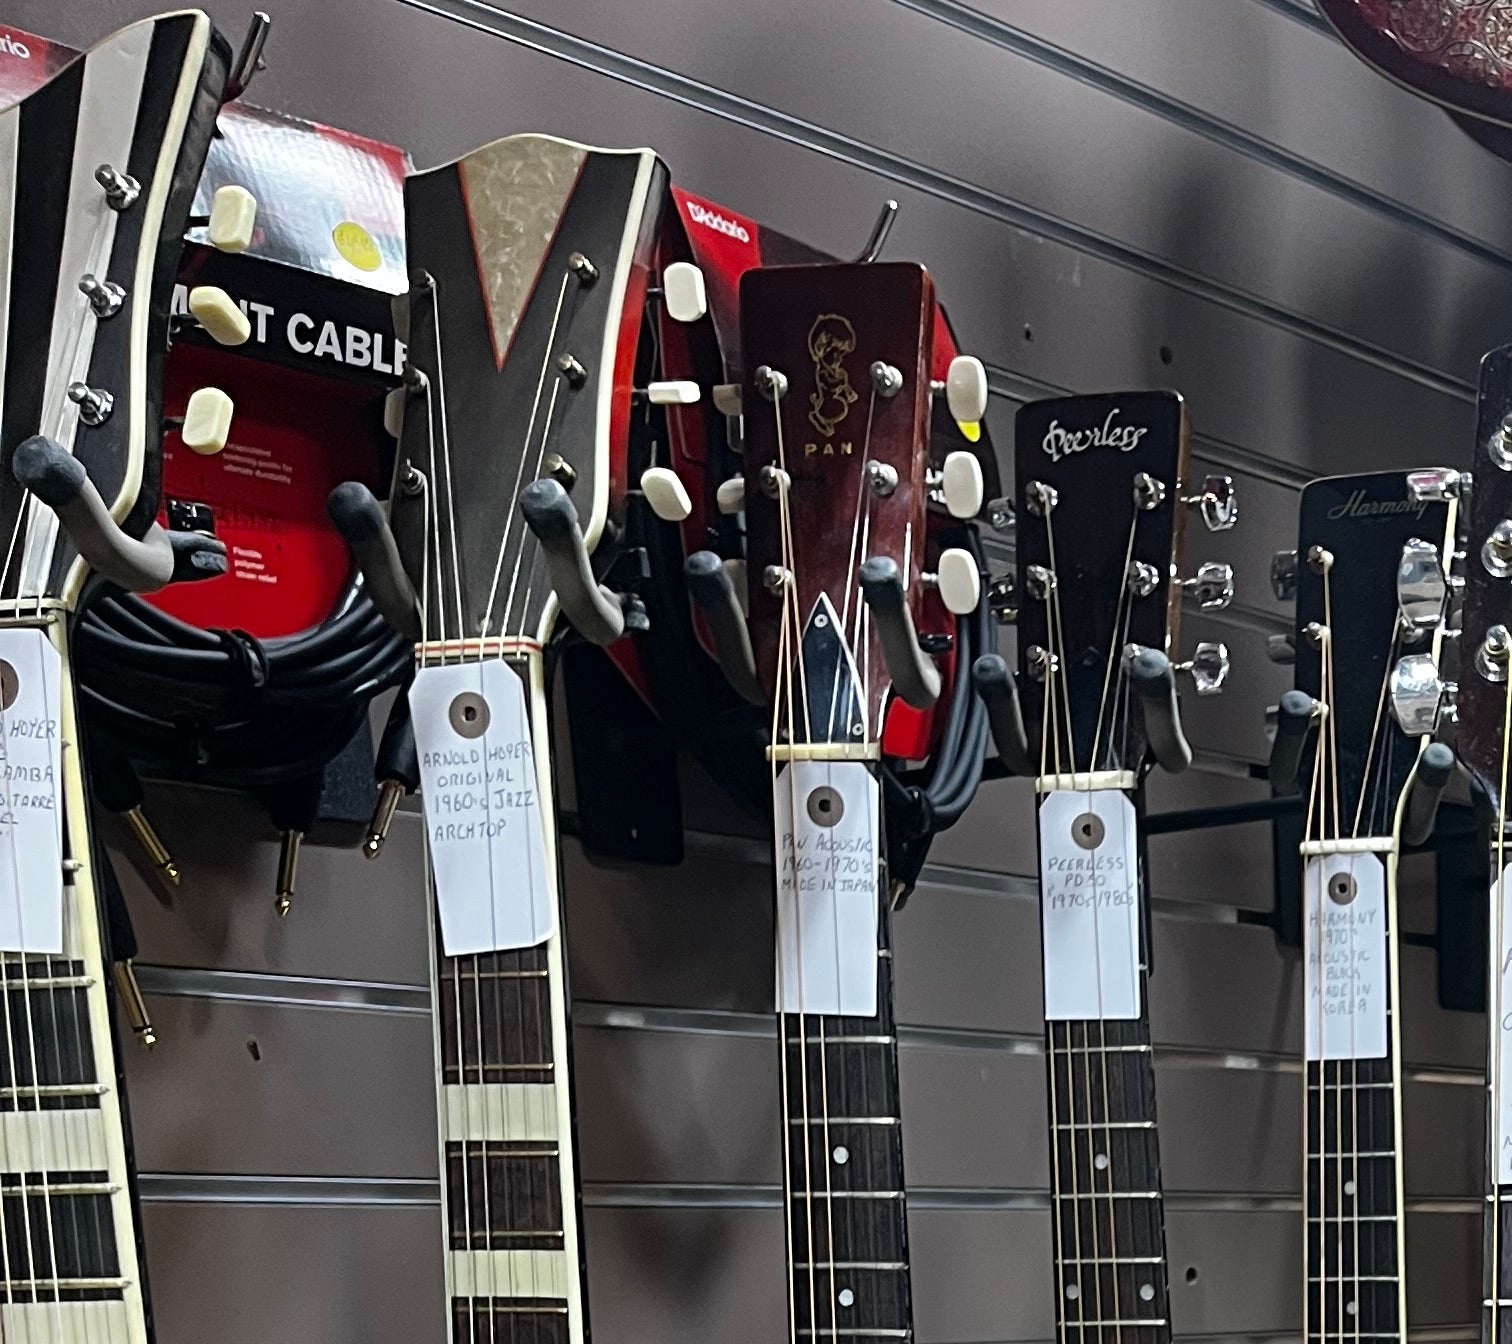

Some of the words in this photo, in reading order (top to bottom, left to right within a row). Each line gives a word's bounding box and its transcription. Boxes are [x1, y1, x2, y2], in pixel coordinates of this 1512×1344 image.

[287, 312, 408, 376] CABLE
[1042, 408, 1148, 462] Peerless
[805, 443, 853, 457] PAN
[1327, 489, 1431, 520] Harmony
[422, 749, 481, 768] ARNOLD
[0, 764, 54, 782] AMBA
[437, 768, 515, 788] ORIGINAL
[494, 788, 535, 810] JAZZ
[1047, 856, 1124, 871] PEERLESS
[821, 877, 836, 890] IN
[838, 880, 879, 893] JAPAN
[1309, 950, 1370, 966] AOUSTIC
